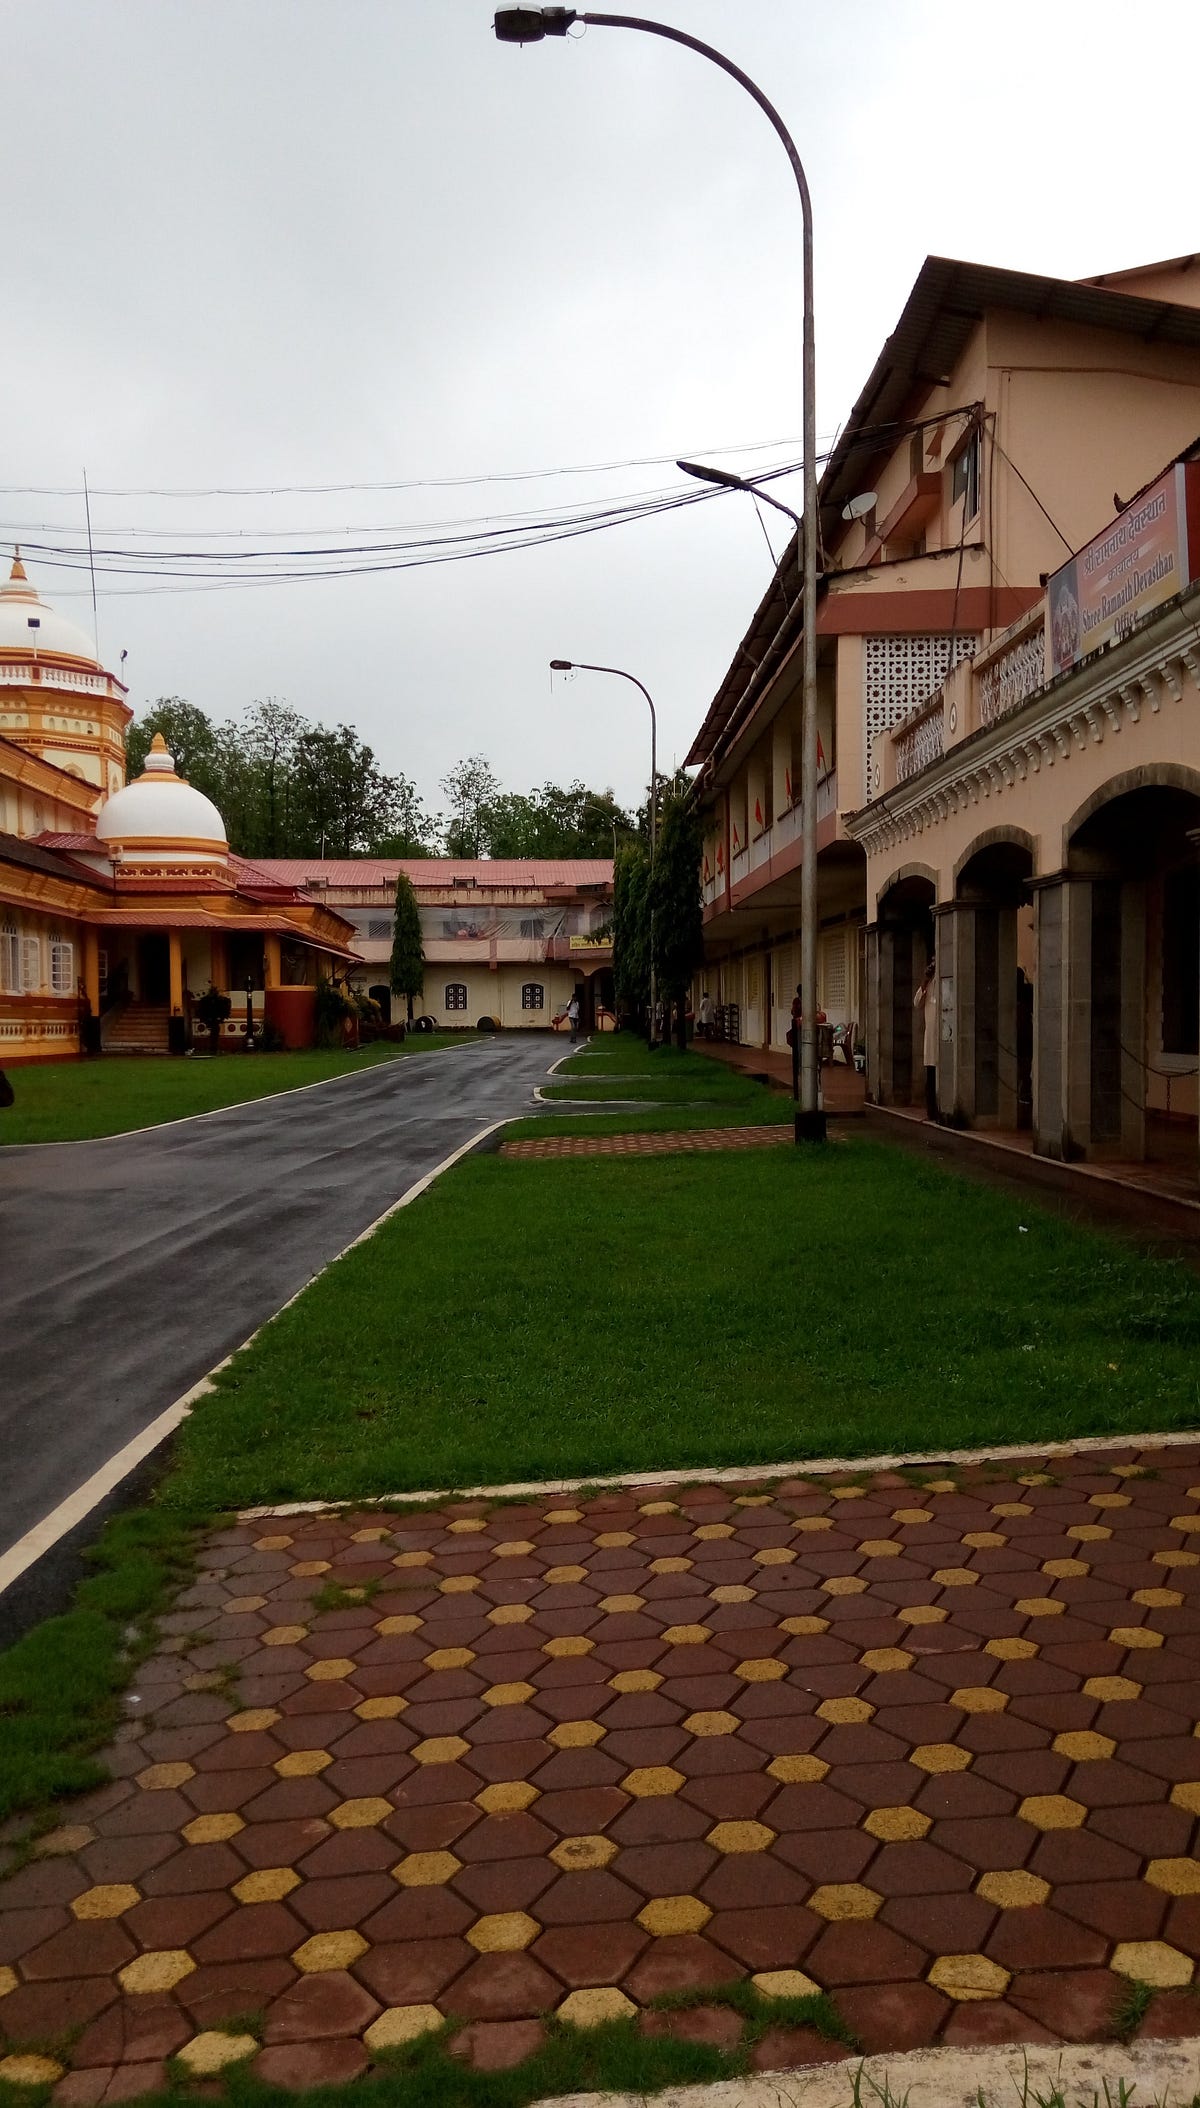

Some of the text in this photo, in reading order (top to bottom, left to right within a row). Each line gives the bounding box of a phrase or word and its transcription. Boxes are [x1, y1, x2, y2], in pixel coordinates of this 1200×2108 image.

[1095, 528, 1127, 566] रामनाथ
[1128, 491, 1166, 542] देवस्थान
[1082, 552, 1174, 634] Shree Ramnath Devasthan
[1114, 610, 1138, 635] Office
